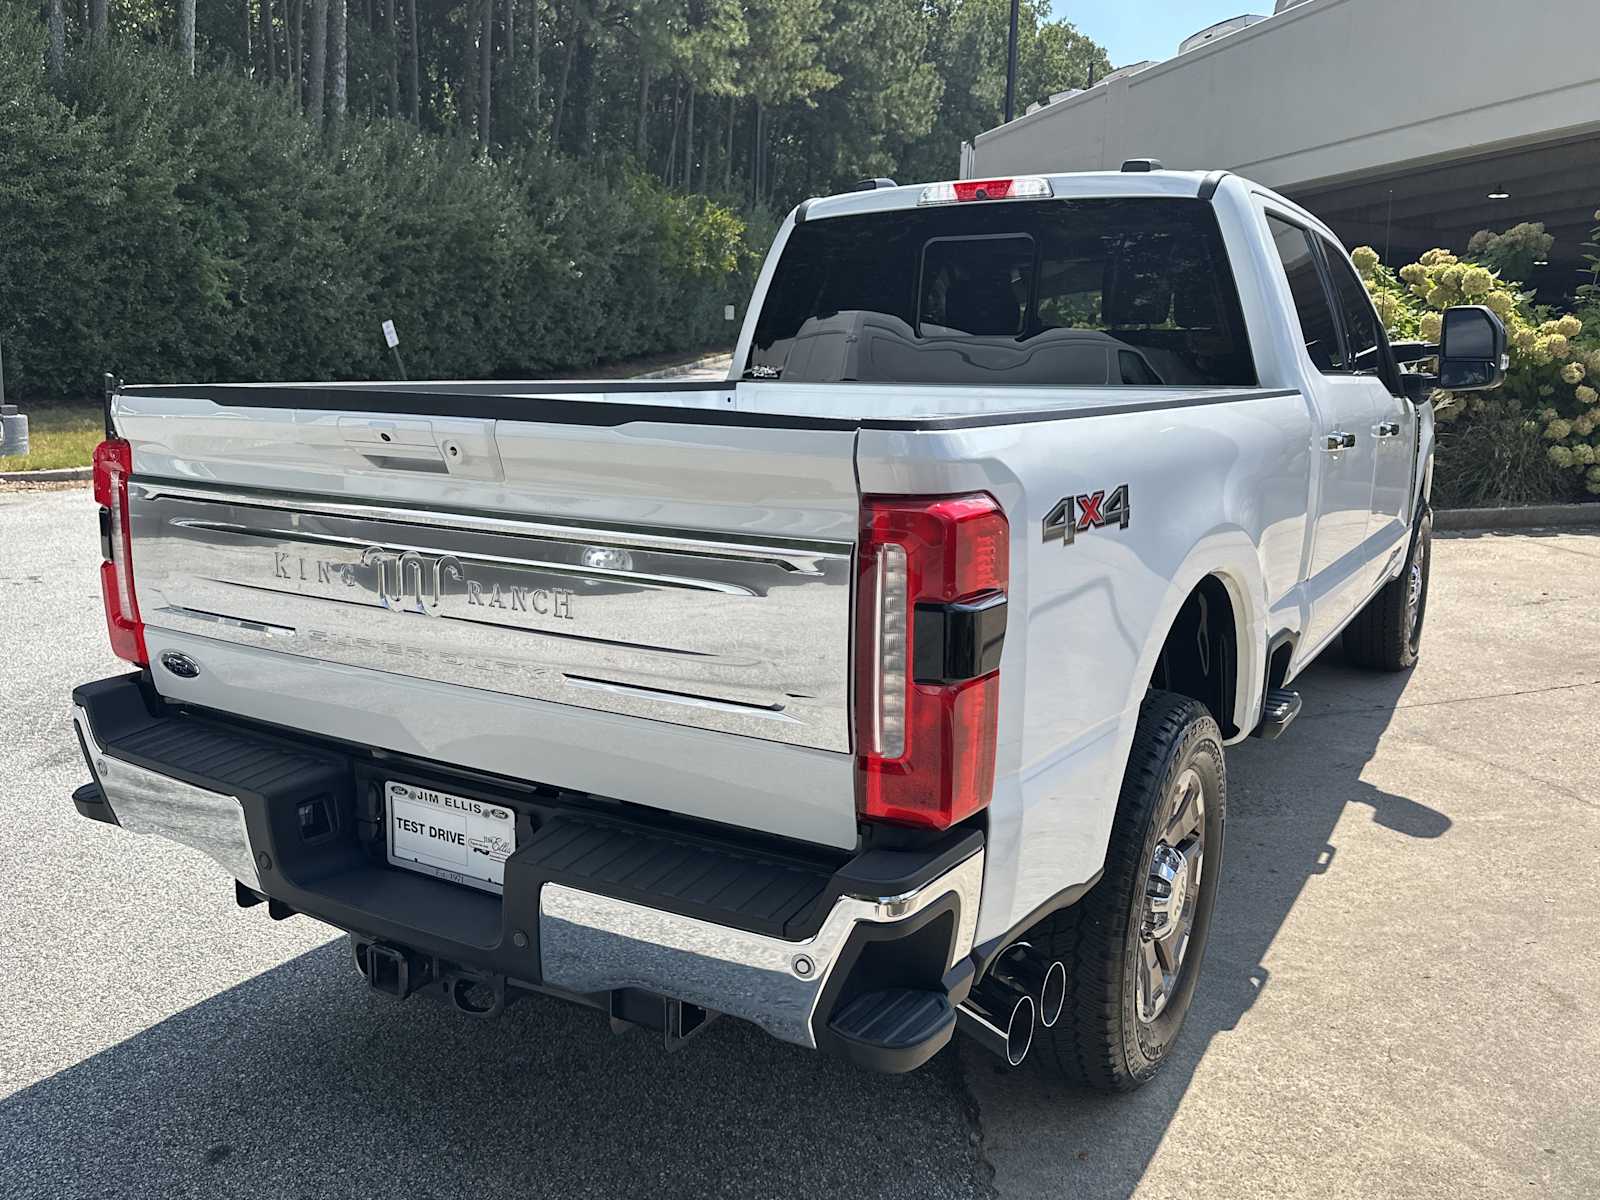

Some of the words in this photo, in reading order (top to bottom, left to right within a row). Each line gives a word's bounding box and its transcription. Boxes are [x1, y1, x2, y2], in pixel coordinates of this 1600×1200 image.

[274, 550, 356, 587] KING
[466, 579, 575, 620] RANCH
[417, 791, 439, 804] JIM
[445, 797, 482, 814] ELLIS
[396, 817, 426, 835] TEST
[429, 826, 466, 846] DRIVE
